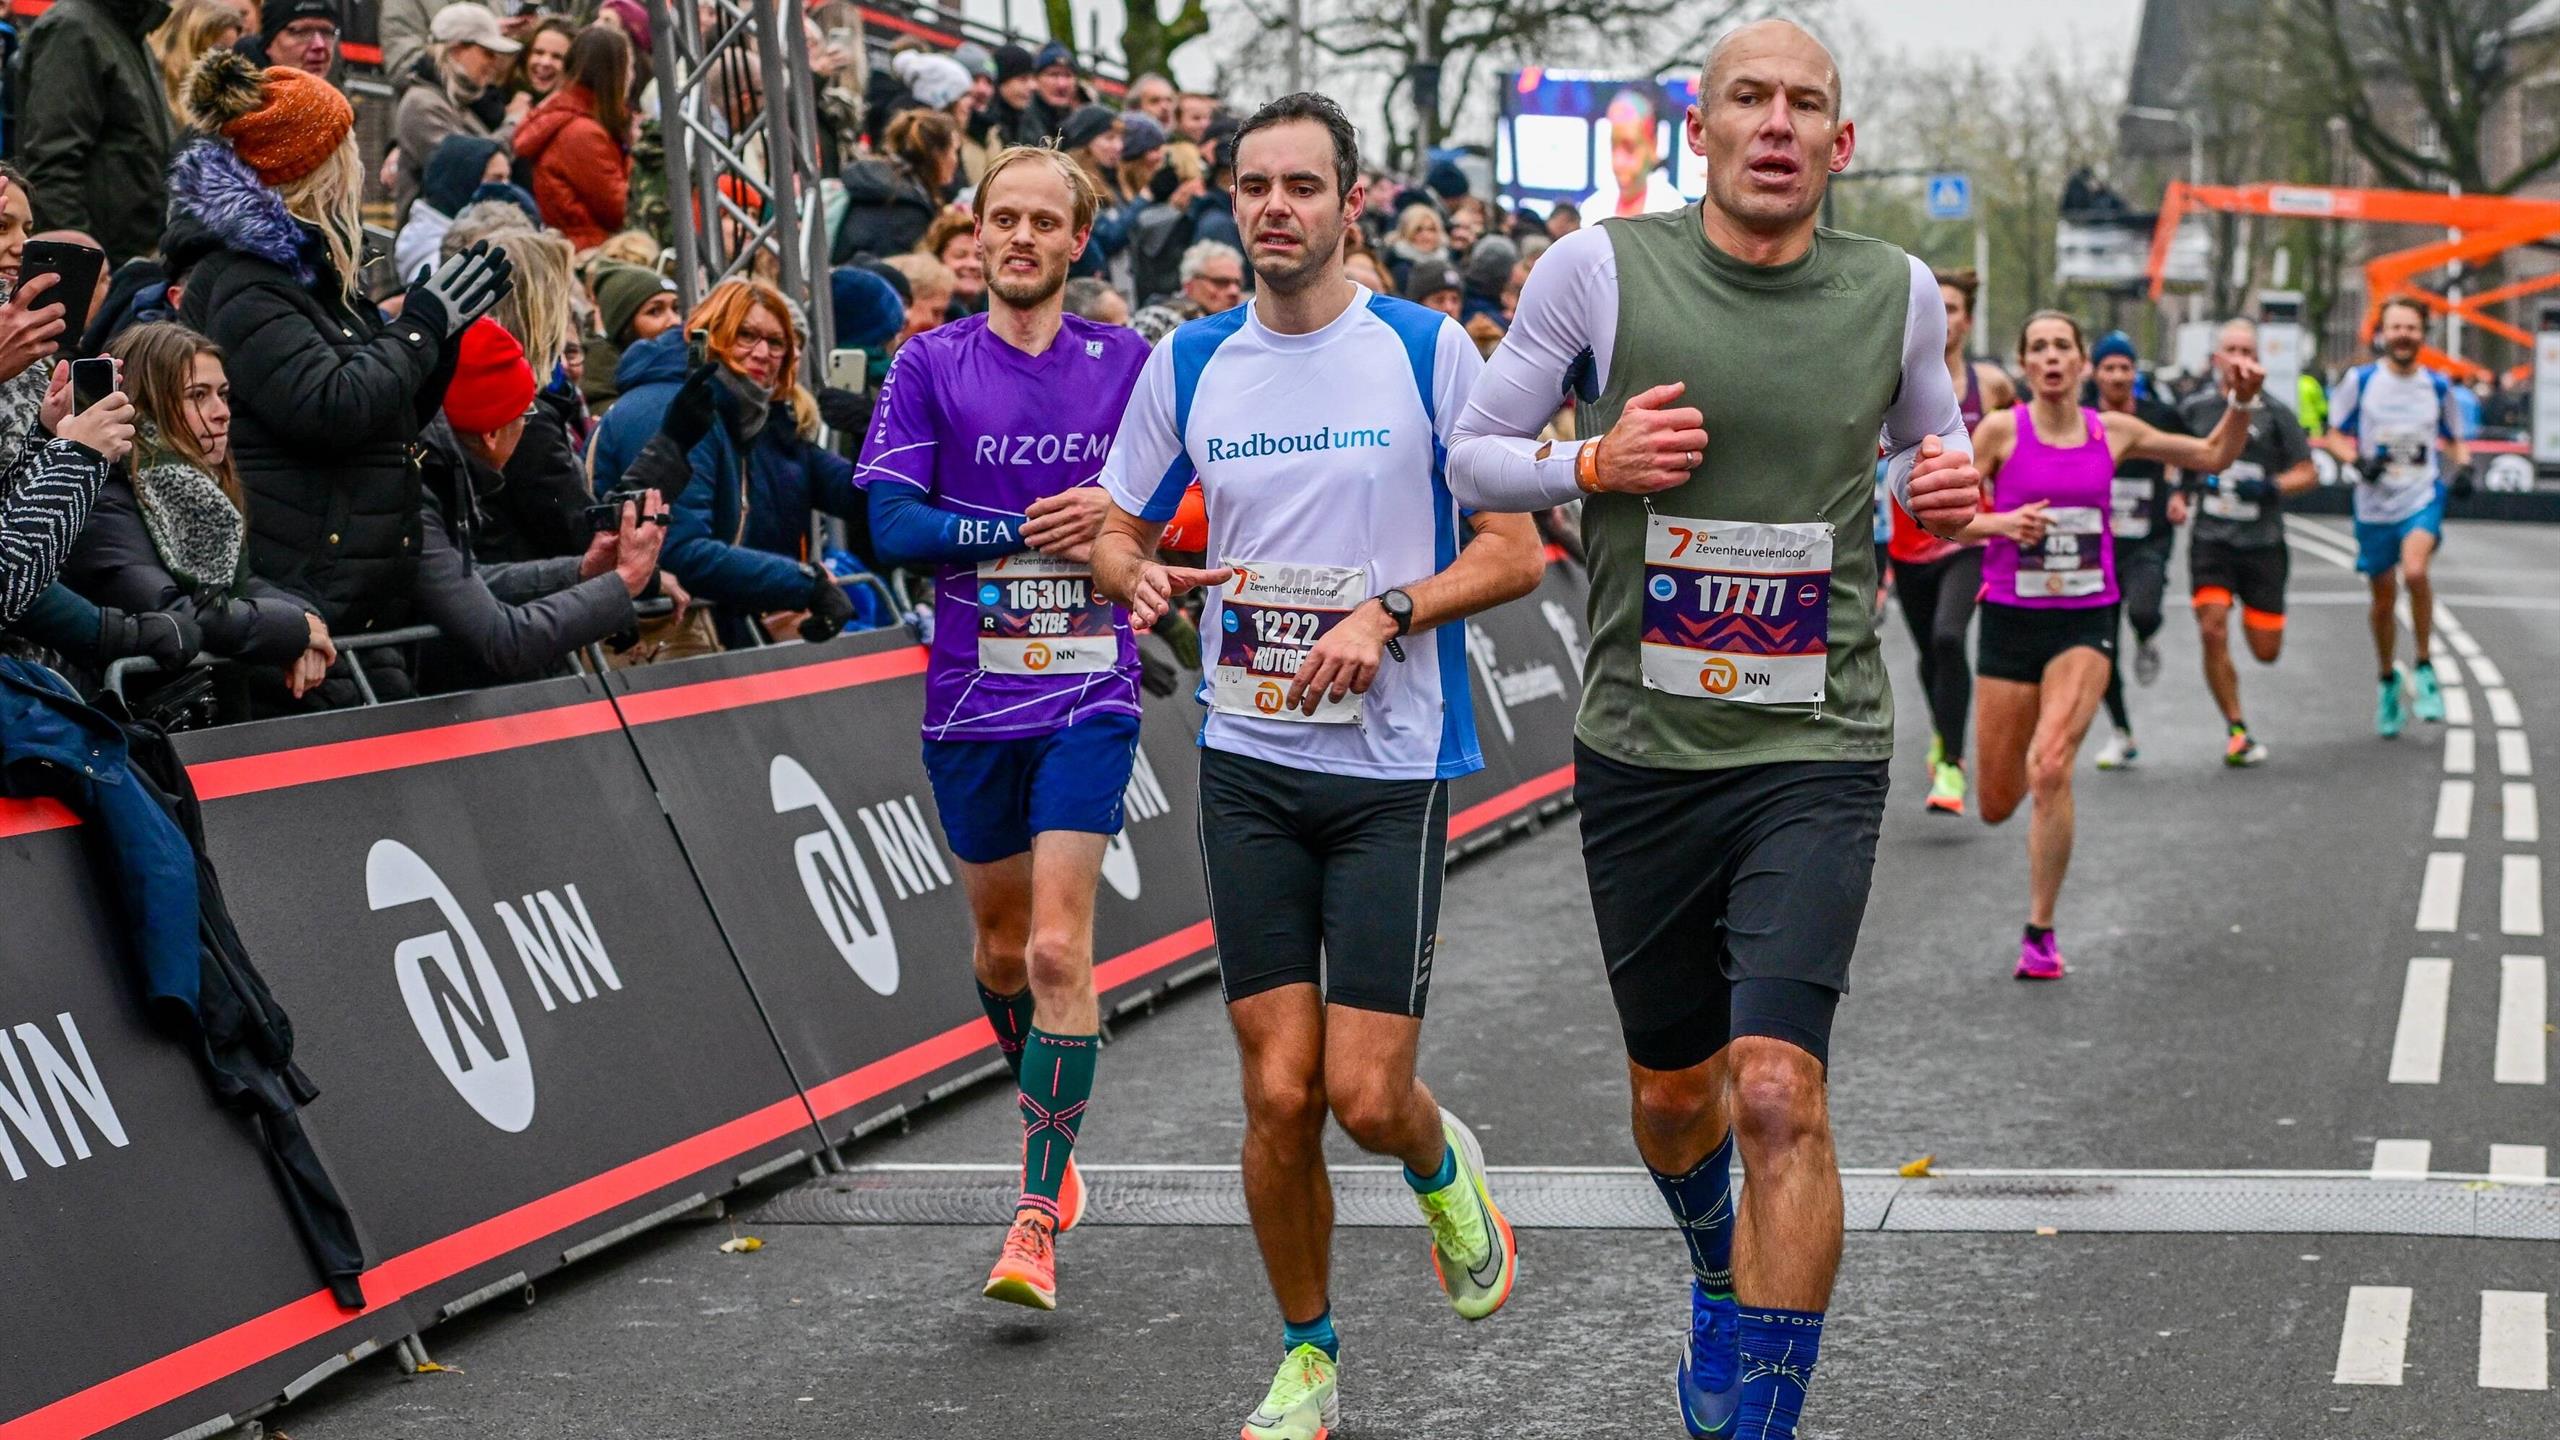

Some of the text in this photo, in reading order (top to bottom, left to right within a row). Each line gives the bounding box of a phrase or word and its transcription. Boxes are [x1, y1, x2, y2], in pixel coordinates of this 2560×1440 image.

[975, 433, 1109, 466] RIZOEM
[1207, 427, 1391, 462] Radboudumc
[1695, 543, 1806, 560] Zevenheuvelenloop
[1006, 580, 1086, 610] 16304
[1250, 582, 1338, 598] Zevenheuvelenloop
[1695, 575, 1787, 616] 17777
[984, 617, 995, 628] R
[1028, 613, 1070, 634] SYBE
[1251, 609, 1320, 646] 1222
[1056, 651, 1075, 660] NN
[1251, 645, 1311, 674] RUTGE
[1744, 672, 1771, 686] NN
[857, 795, 953, 900] NN
[493, 883, 623, 1011] NN
[1040, 1036, 1088, 1047] STOX
[1762, 1315, 1819, 1328] STOX
